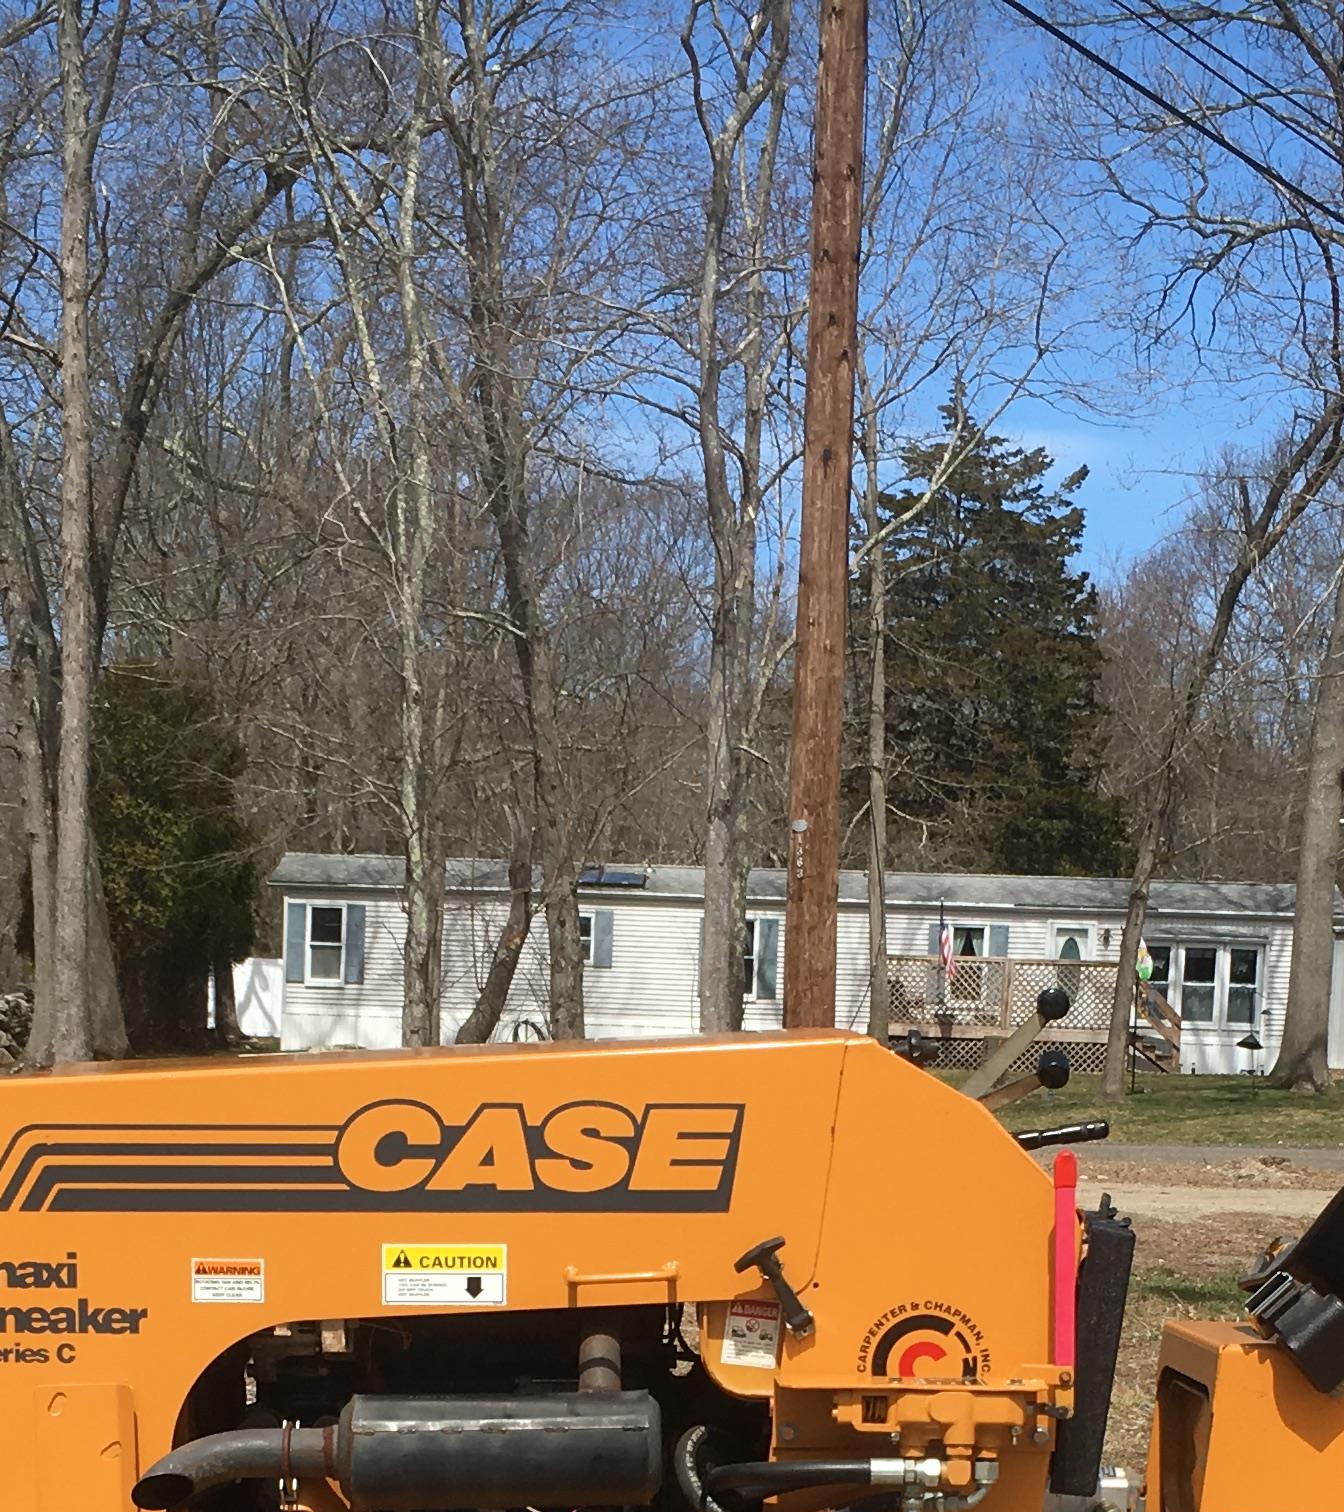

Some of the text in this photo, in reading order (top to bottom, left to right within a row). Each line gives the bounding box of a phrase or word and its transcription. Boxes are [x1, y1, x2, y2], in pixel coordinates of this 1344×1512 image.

[335, 1098, 745, 1205] CASE
[207, 1265, 261, 1276] WARNING
[419, 1255, 498, 1269] CAUTION
[857, 1303, 908, 1373] CARPENTER
[910, 1301, 920, 1311] &
[56, 1343, 76, 1364] C
